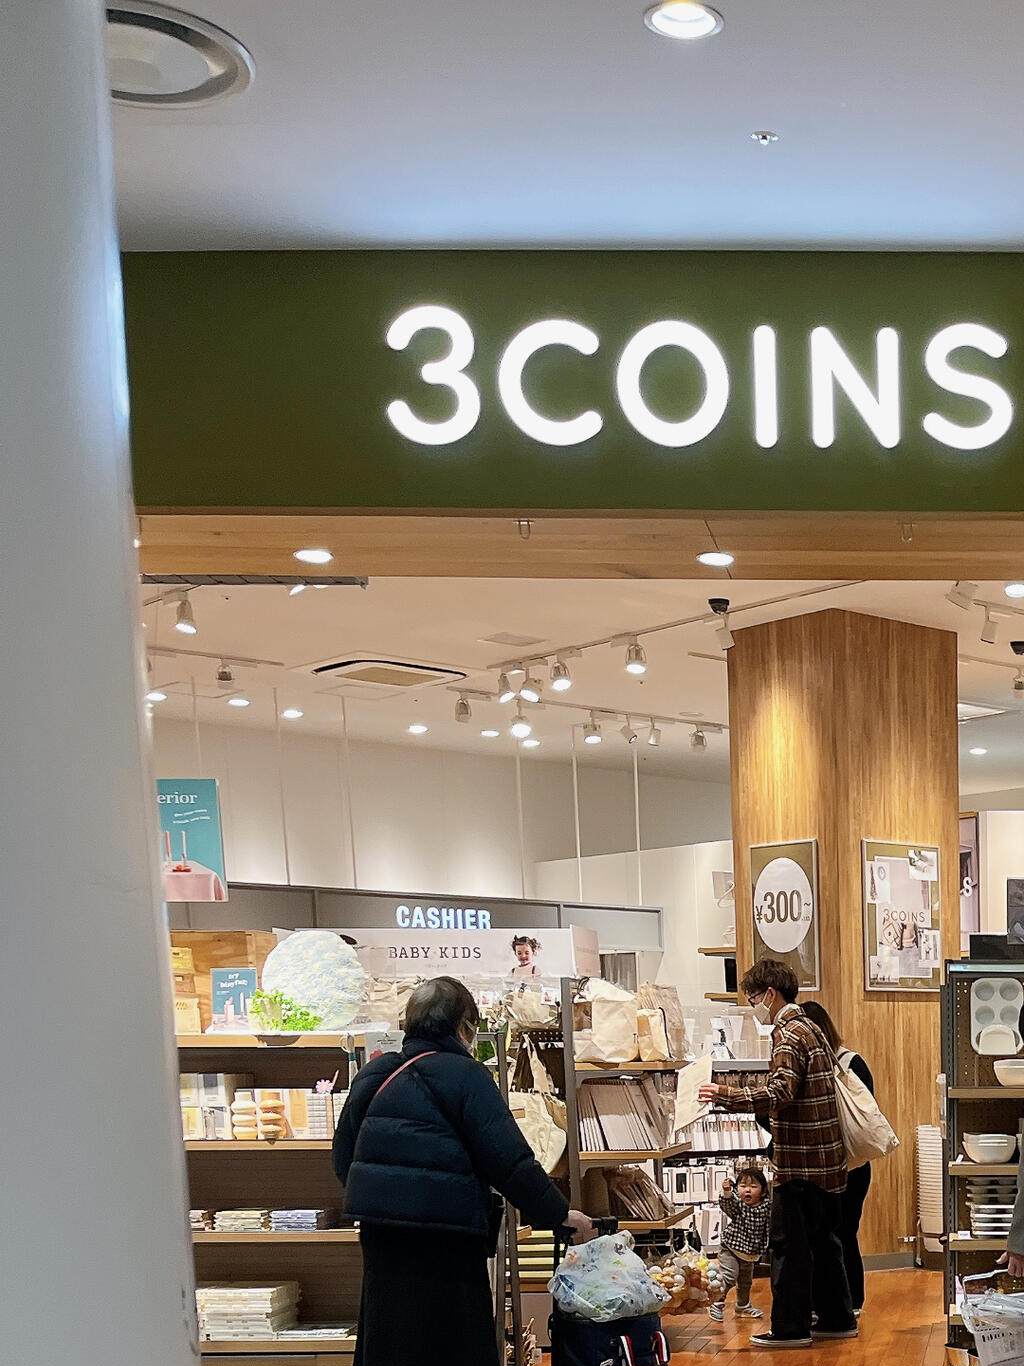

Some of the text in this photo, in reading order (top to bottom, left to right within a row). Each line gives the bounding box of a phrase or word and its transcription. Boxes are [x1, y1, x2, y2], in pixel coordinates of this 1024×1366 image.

[387, 305, 1014, 449] 3COINS
[396, 905, 491, 930] CASHIER
[883, 908, 926, 923] 3COINS
[388, 947, 482, 959] BABY KIDS
